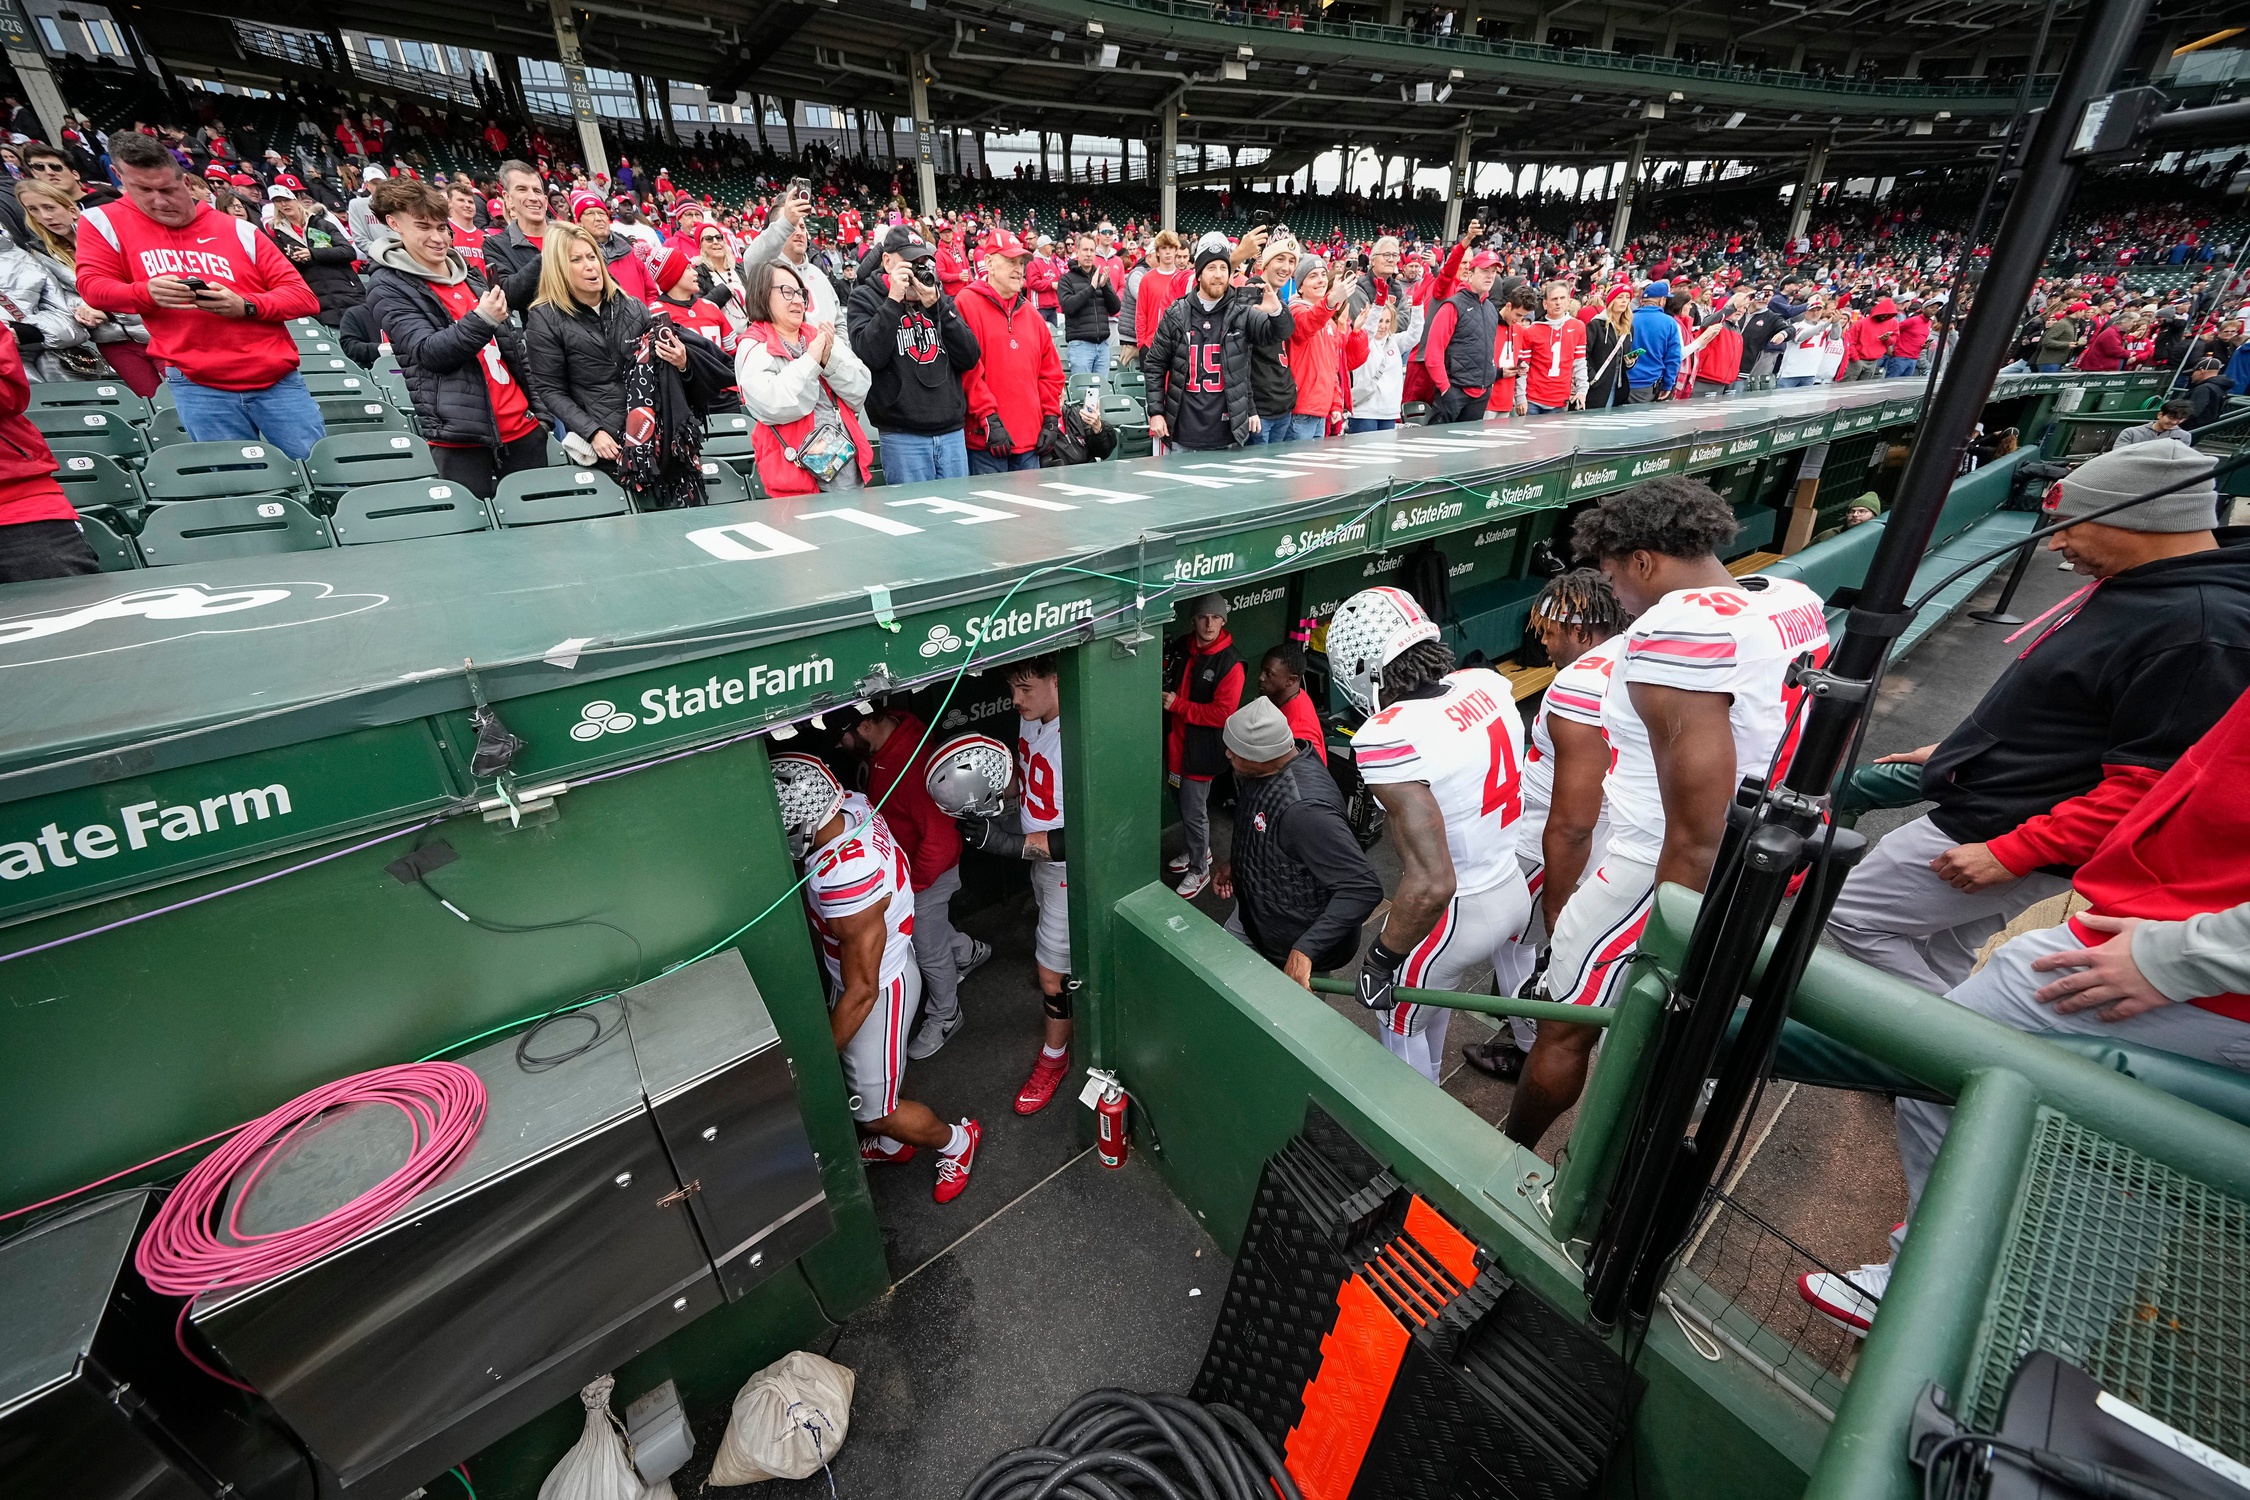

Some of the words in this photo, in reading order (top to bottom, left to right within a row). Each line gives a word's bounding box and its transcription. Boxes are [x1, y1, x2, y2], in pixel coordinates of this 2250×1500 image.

[572, 82, 587, 93] 226
[576, 98, 591, 110] 225
[920, 132, 930, 141] 225
[140, 248, 235, 282] BUCKEYES
[1186, 343, 1224, 393] 15
[1548, 341, 1561, 377] 1
[77, 459, 86, 468] 9
[267, 505, 276, 514] 8
[685, 482, 1155, 561] FIELD
[1372, 706, 1404, 725] 4
[1445, 688, 1498, 732] SMITH
[1480, 715, 1522, 830] 4
[815, 838, 865, 878] 32
